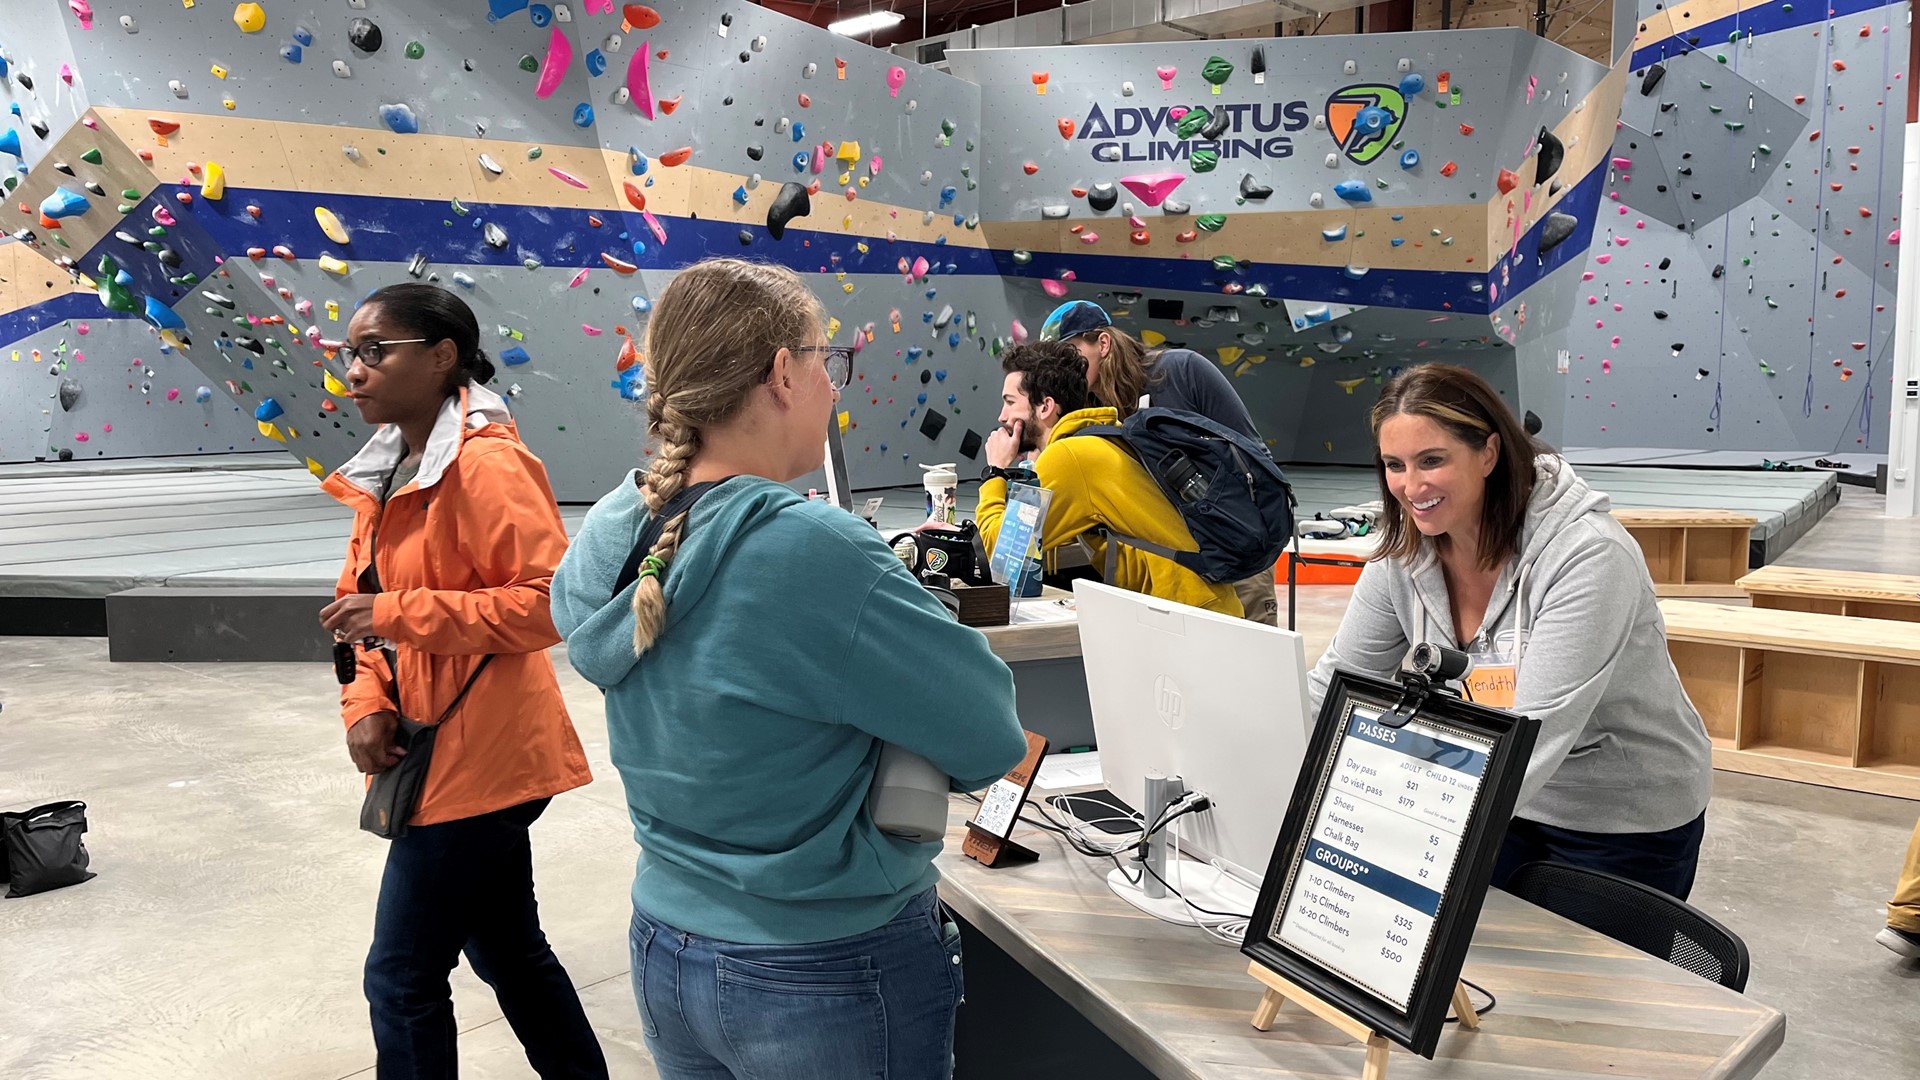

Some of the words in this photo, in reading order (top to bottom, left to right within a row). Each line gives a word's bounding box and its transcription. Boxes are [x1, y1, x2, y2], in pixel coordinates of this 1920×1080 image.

[1090, 137, 1294, 163] CLIMBING
[1357, 721, 1397, 744] PASSES
[1346, 758, 1361, 774] Day
[1360, 765, 1377, 777] pass
[1400, 762, 1422, 774] ADULT
[1426, 769, 1447, 783] CHILD
[1448, 777, 1457, 786] 12
[1340, 774, 1349, 784] 10
[1350, 777, 1365, 790] visit
[1365, 784, 1383, 797] pass
[1406, 780, 1419, 791] $21
[1333, 795, 1355, 812] Shoes
[1398, 795, 1415, 809] $179
[1441, 792, 1454, 804] $17
[1328, 810, 1364, 834] Harnesses
[1323, 826, 1344, 843] Chalk
[1344, 835, 1360, 851] Bag
[1428, 834, 1439, 846] $5
[1423, 851, 1435, 863] $4
[1418, 868, 1428, 879] $2
[1308, 874, 1322, 886] 1-10
[1323, 879, 1355, 902] Climbers
[1303, 889, 1318, 904] 11-15
[1318, 895, 1350, 919] Climbers
[1298, 905, 1317, 920] 16-20
[1318, 913, 1350, 937] Climbers
[1393, 914, 1413, 931] $325
[1385, 929, 1408, 947] $400
[1380, 946, 1402, 963] $500
